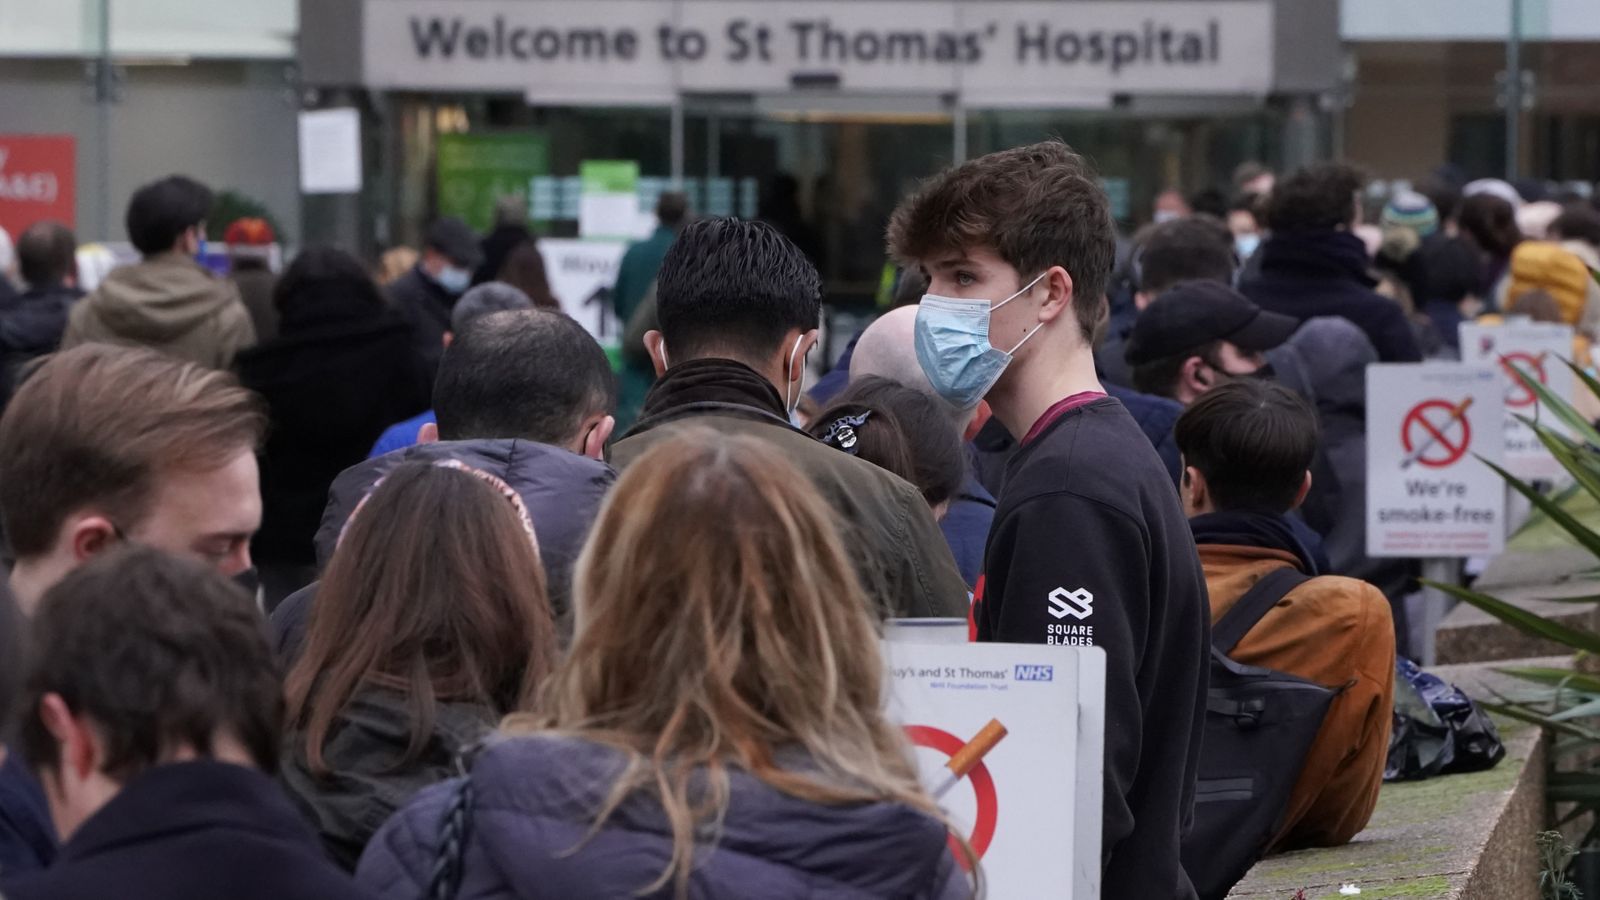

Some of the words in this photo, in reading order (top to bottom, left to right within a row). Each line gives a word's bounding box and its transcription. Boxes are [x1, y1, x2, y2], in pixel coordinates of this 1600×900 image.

[410, 17, 639, 60] Welcome
[658, 25, 707, 61] to
[726, 20, 771, 62] St
[790, 22, 997, 63] Thomas'
[1016, 20, 1219, 73] Hospital
[1405, 480, 1467, 497] We're
[1377, 504, 1495, 523] smoke-free
[1047, 624, 1093, 636] SQUARE
[1047, 635, 1093, 647] BLADES
[887, 666, 915, 680] uy's
[918, 667, 941, 678] and
[944, 667, 956, 679] St
[960, 668, 1008, 680] Thomas'
[1015, 665, 1053, 681] NHS
[947, 682, 988, 690] Foundation
